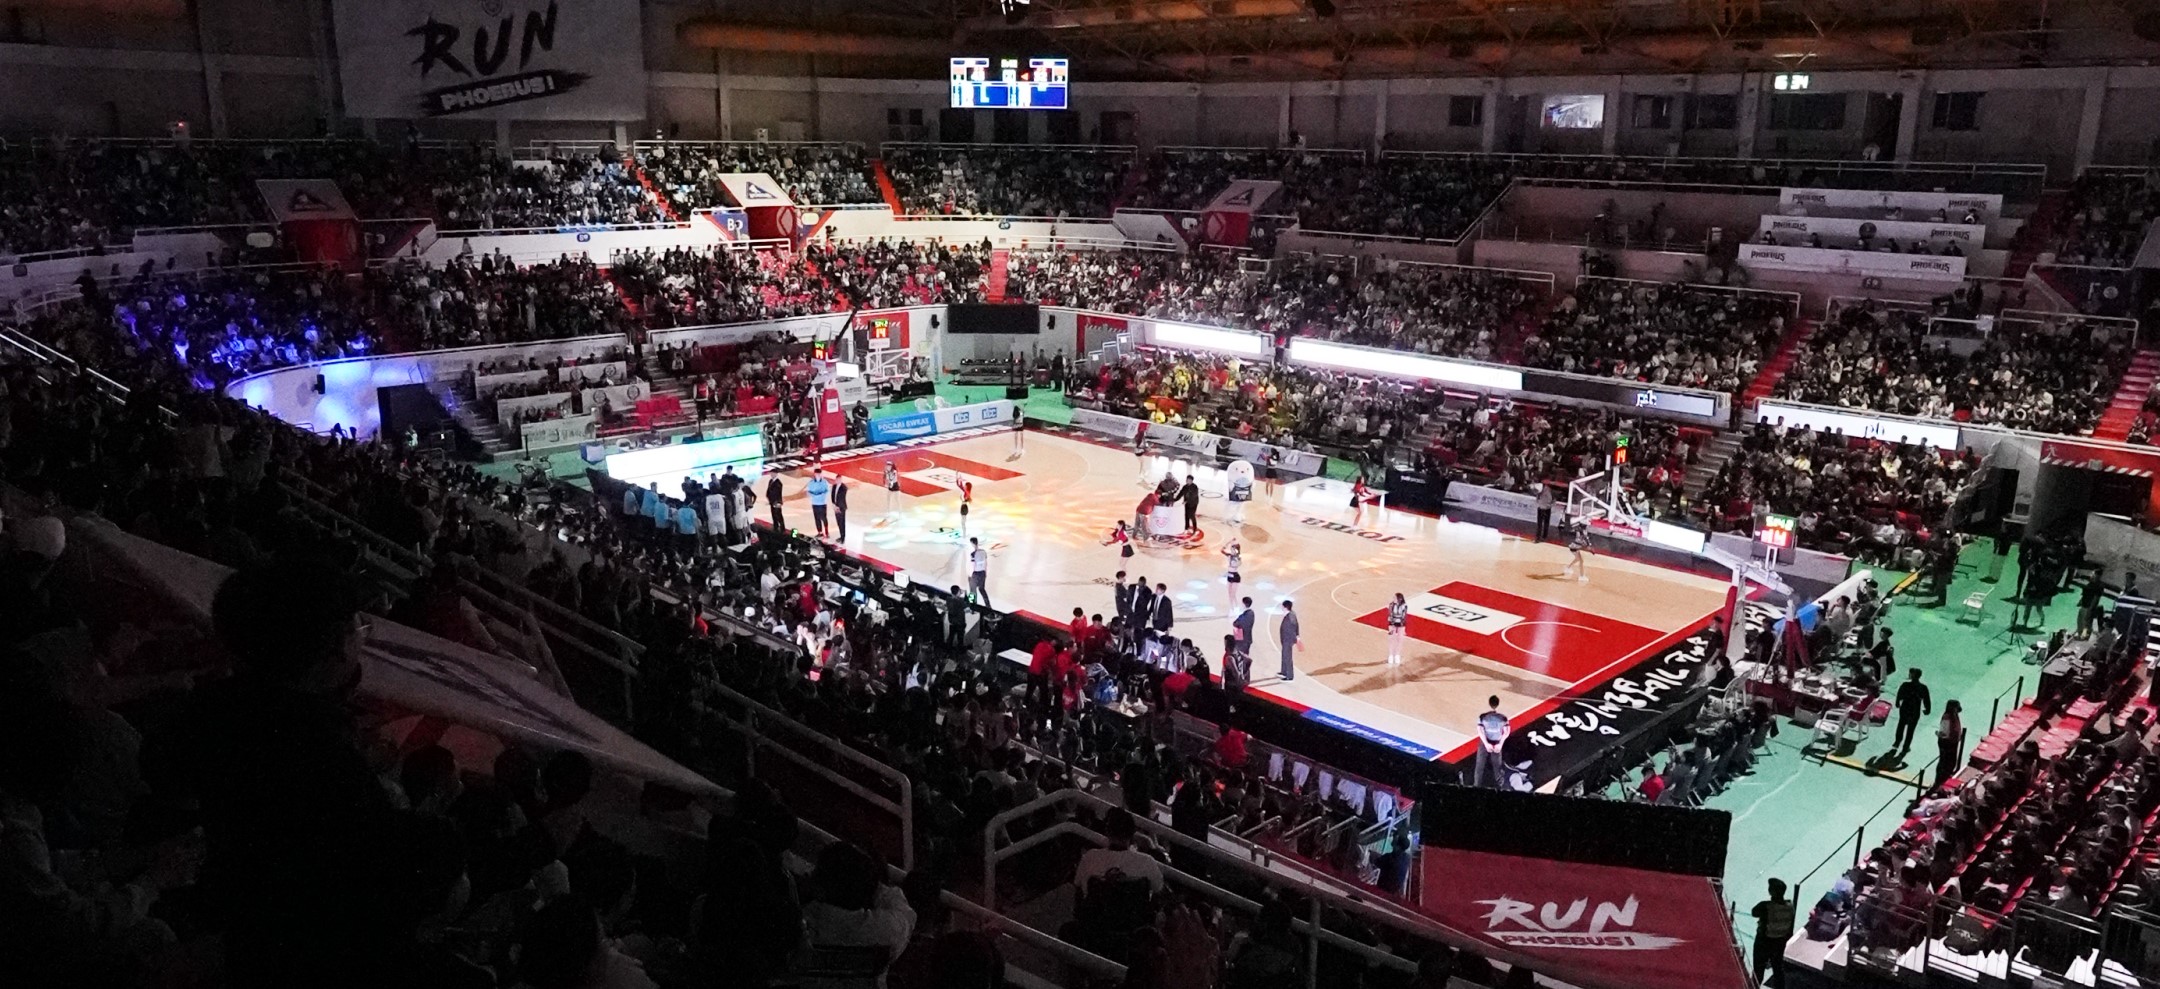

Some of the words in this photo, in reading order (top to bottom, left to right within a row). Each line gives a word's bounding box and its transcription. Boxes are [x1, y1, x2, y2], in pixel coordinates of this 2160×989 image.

[403, 1, 558, 78] RUN
[440, 75, 556, 111] PHOEBUS!
[877, 421, 905, 431] POCARI
[906, 418, 930, 428] SWEAT
[1472, 893, 1640, 935] RUN
[1500, 934, 1636, 947] PHOEBUS!
